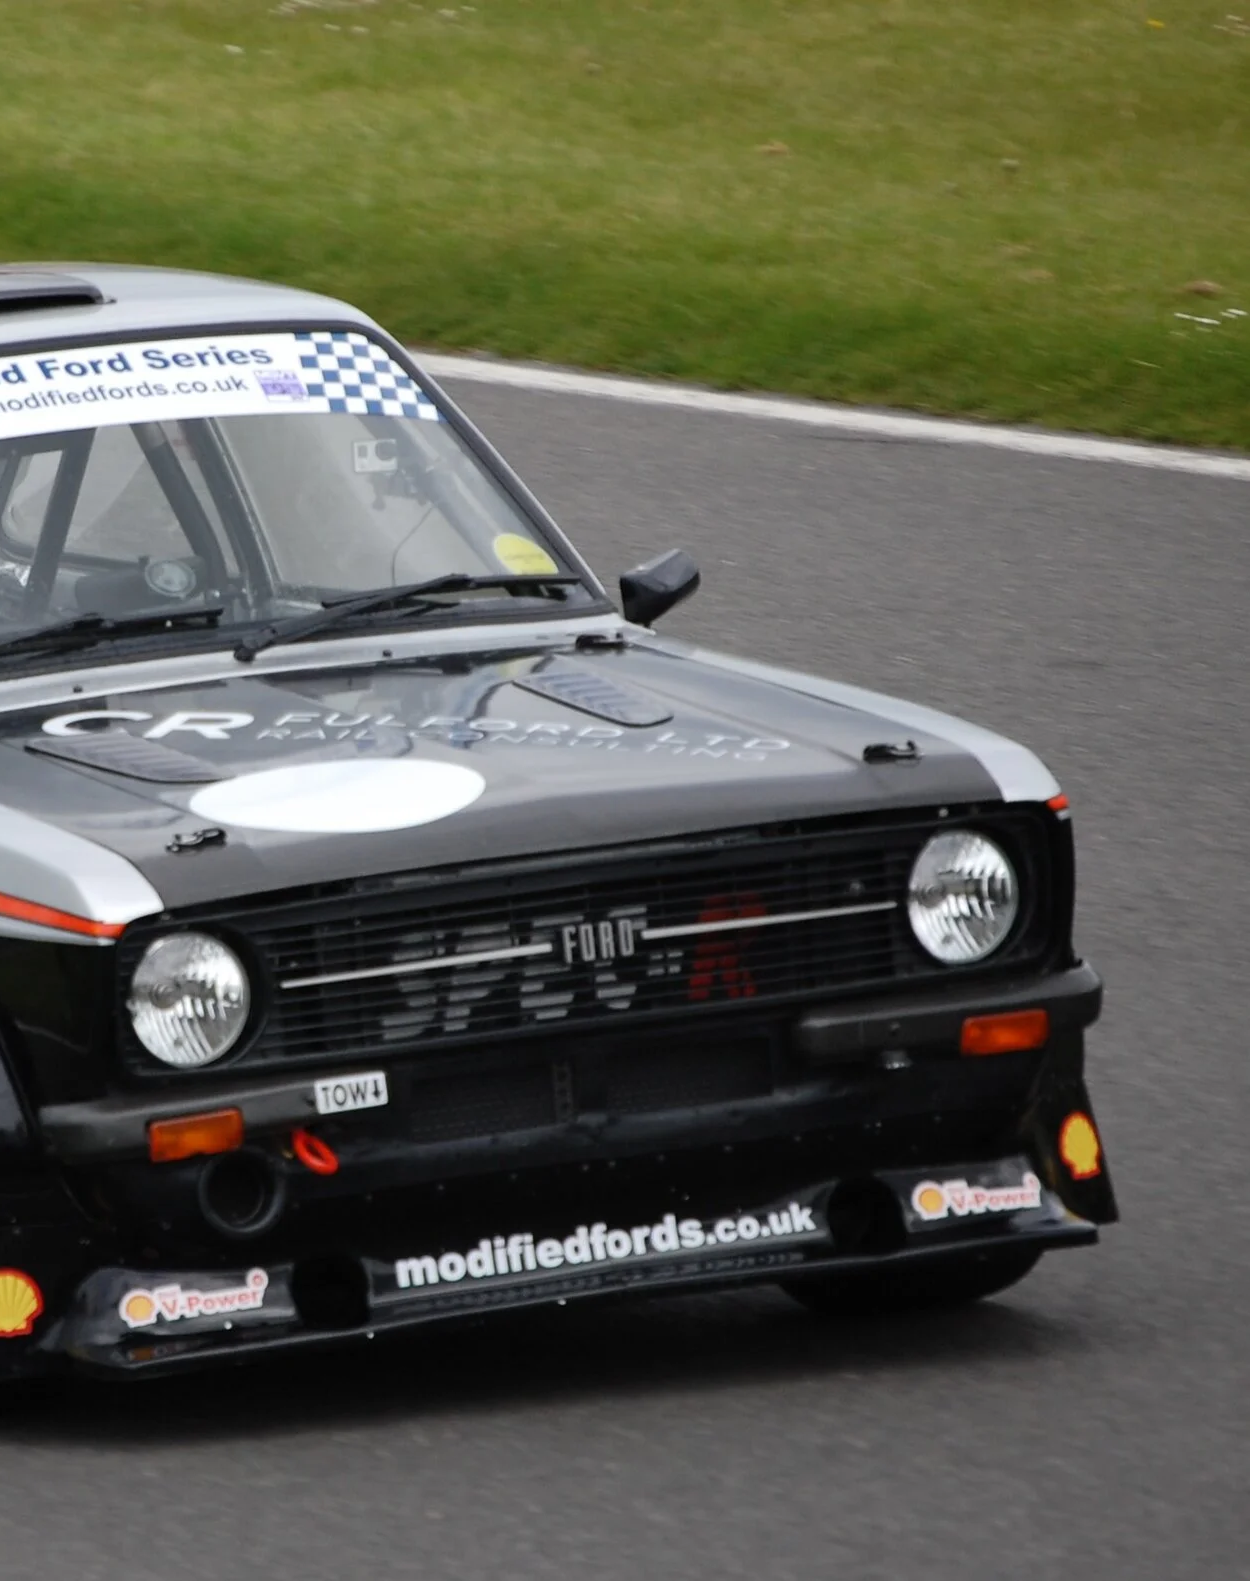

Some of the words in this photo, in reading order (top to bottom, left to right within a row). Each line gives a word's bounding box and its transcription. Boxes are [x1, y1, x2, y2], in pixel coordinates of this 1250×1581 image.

[36, 351, 133, 381] Ford
[141, 346, 274, 370] Series
[41, 710, 255, 740] CR
[563, 918, 635, 963] FORD
[322, 1081, 368, 1110] TOW
[395, 1201, 817, 1289] modifiedfords.co.uk
[161, 1291, 261, 1316] V-Power
